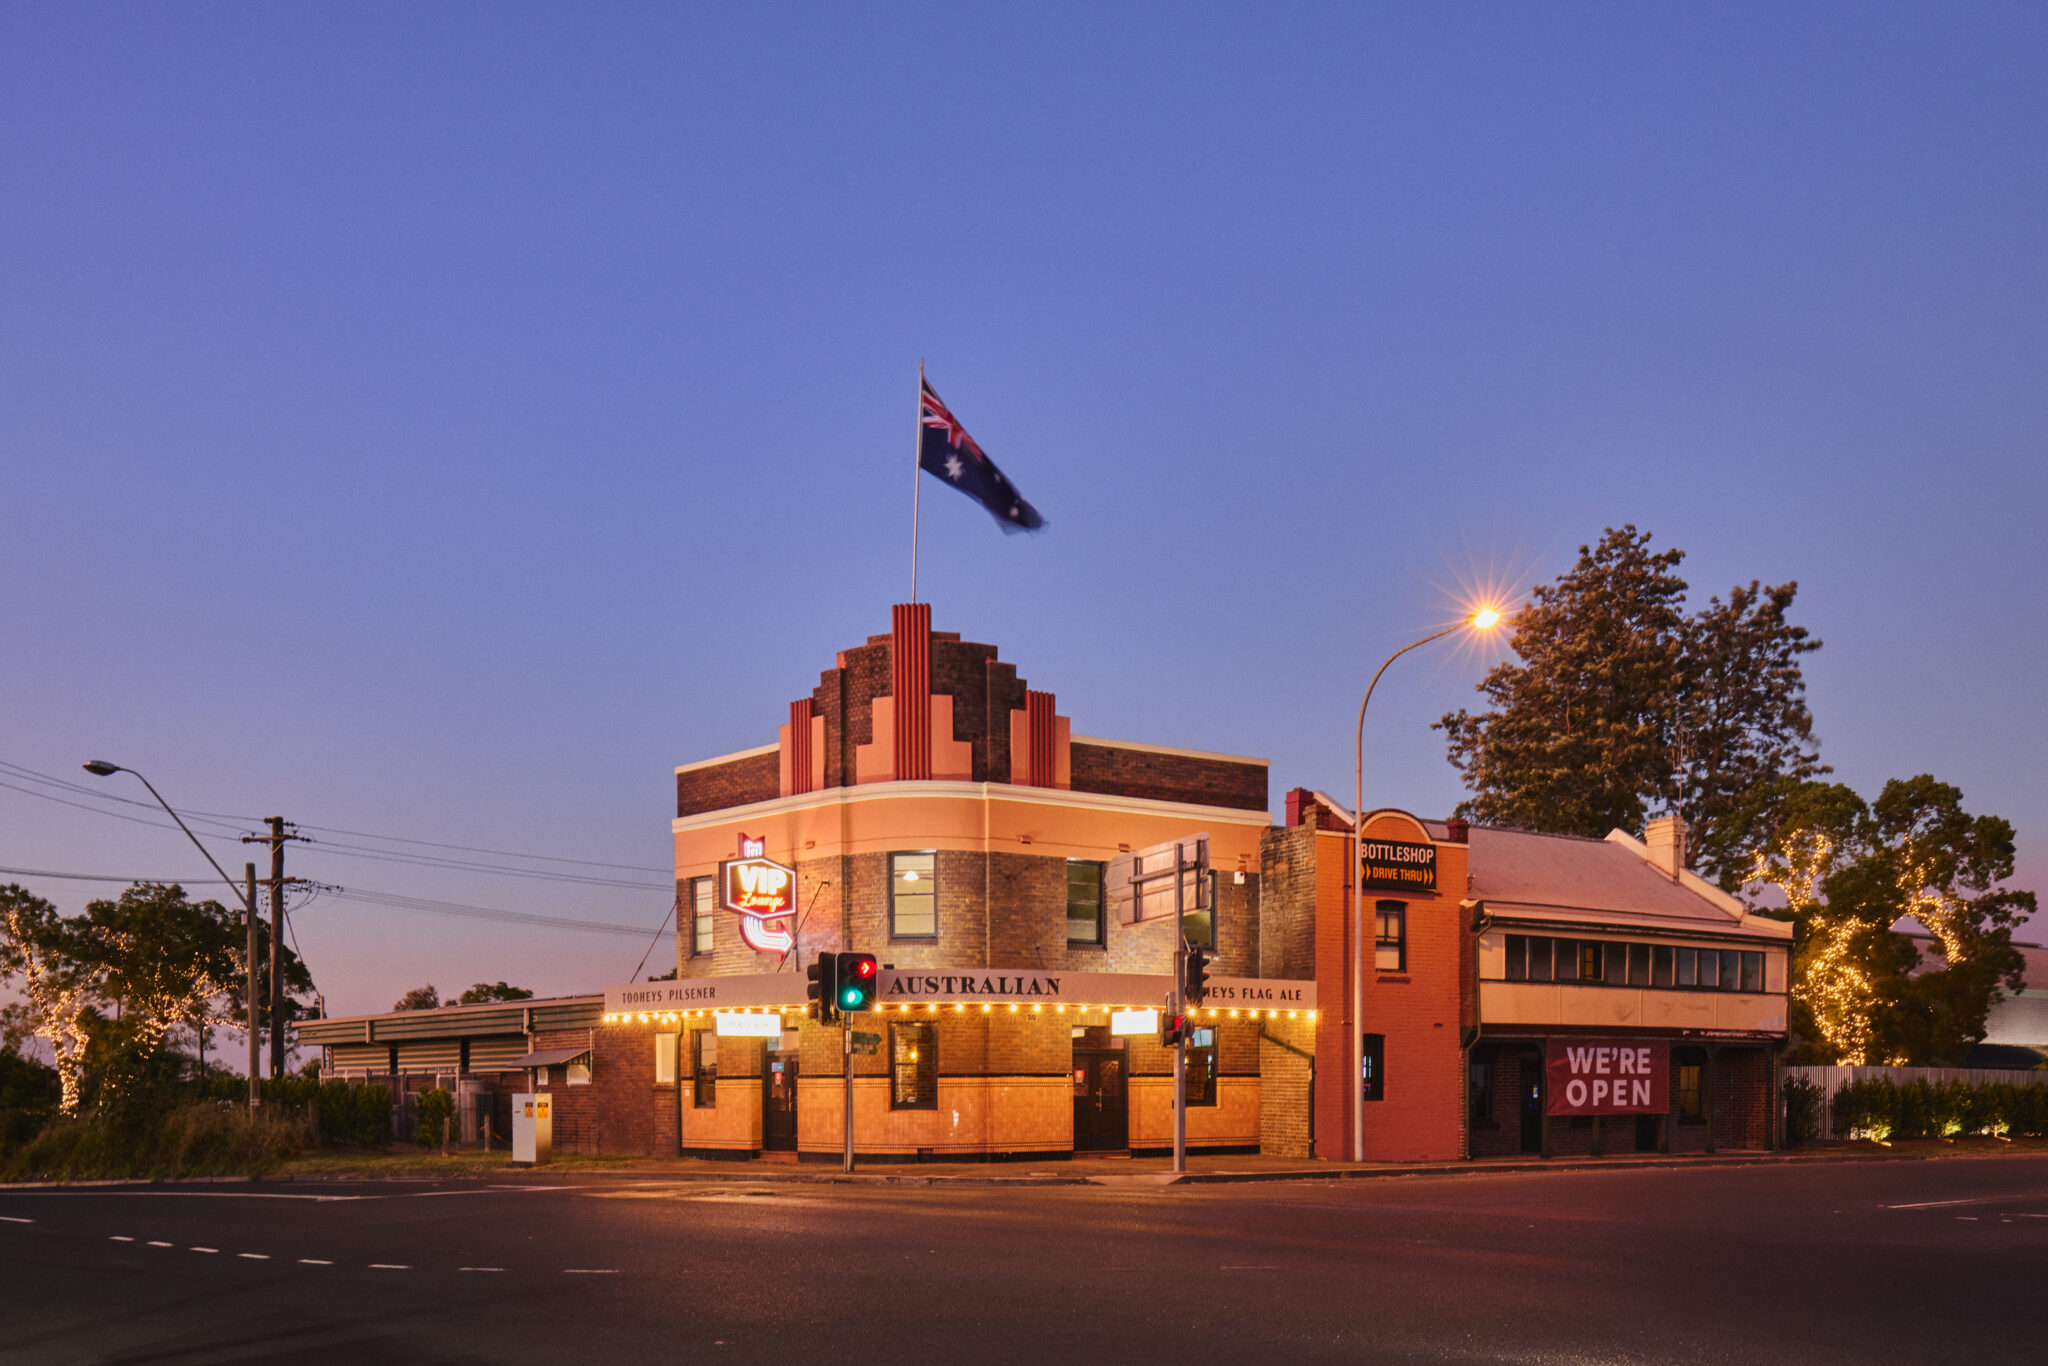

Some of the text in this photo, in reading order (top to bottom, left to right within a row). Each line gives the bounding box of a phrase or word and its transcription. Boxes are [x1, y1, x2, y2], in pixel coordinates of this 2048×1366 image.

[1361, 843, 1434, 863] BOTTLESHOP
[738, 864, 787, 895] VIP
[1373, 866, 1422, 882] DRIVE THRU
[739, 892, 785, 912] Lounge
[888, 976, 1062, 995] AUSTRALIAN
[1242, 988, 1273, 1000] FLAG
[1280, 989, 1302, 1001] ALE
[622, 987, 716, 1004] TOOHEYS PILSENER
[1566, 1079, 1651, 1107] OPEN
